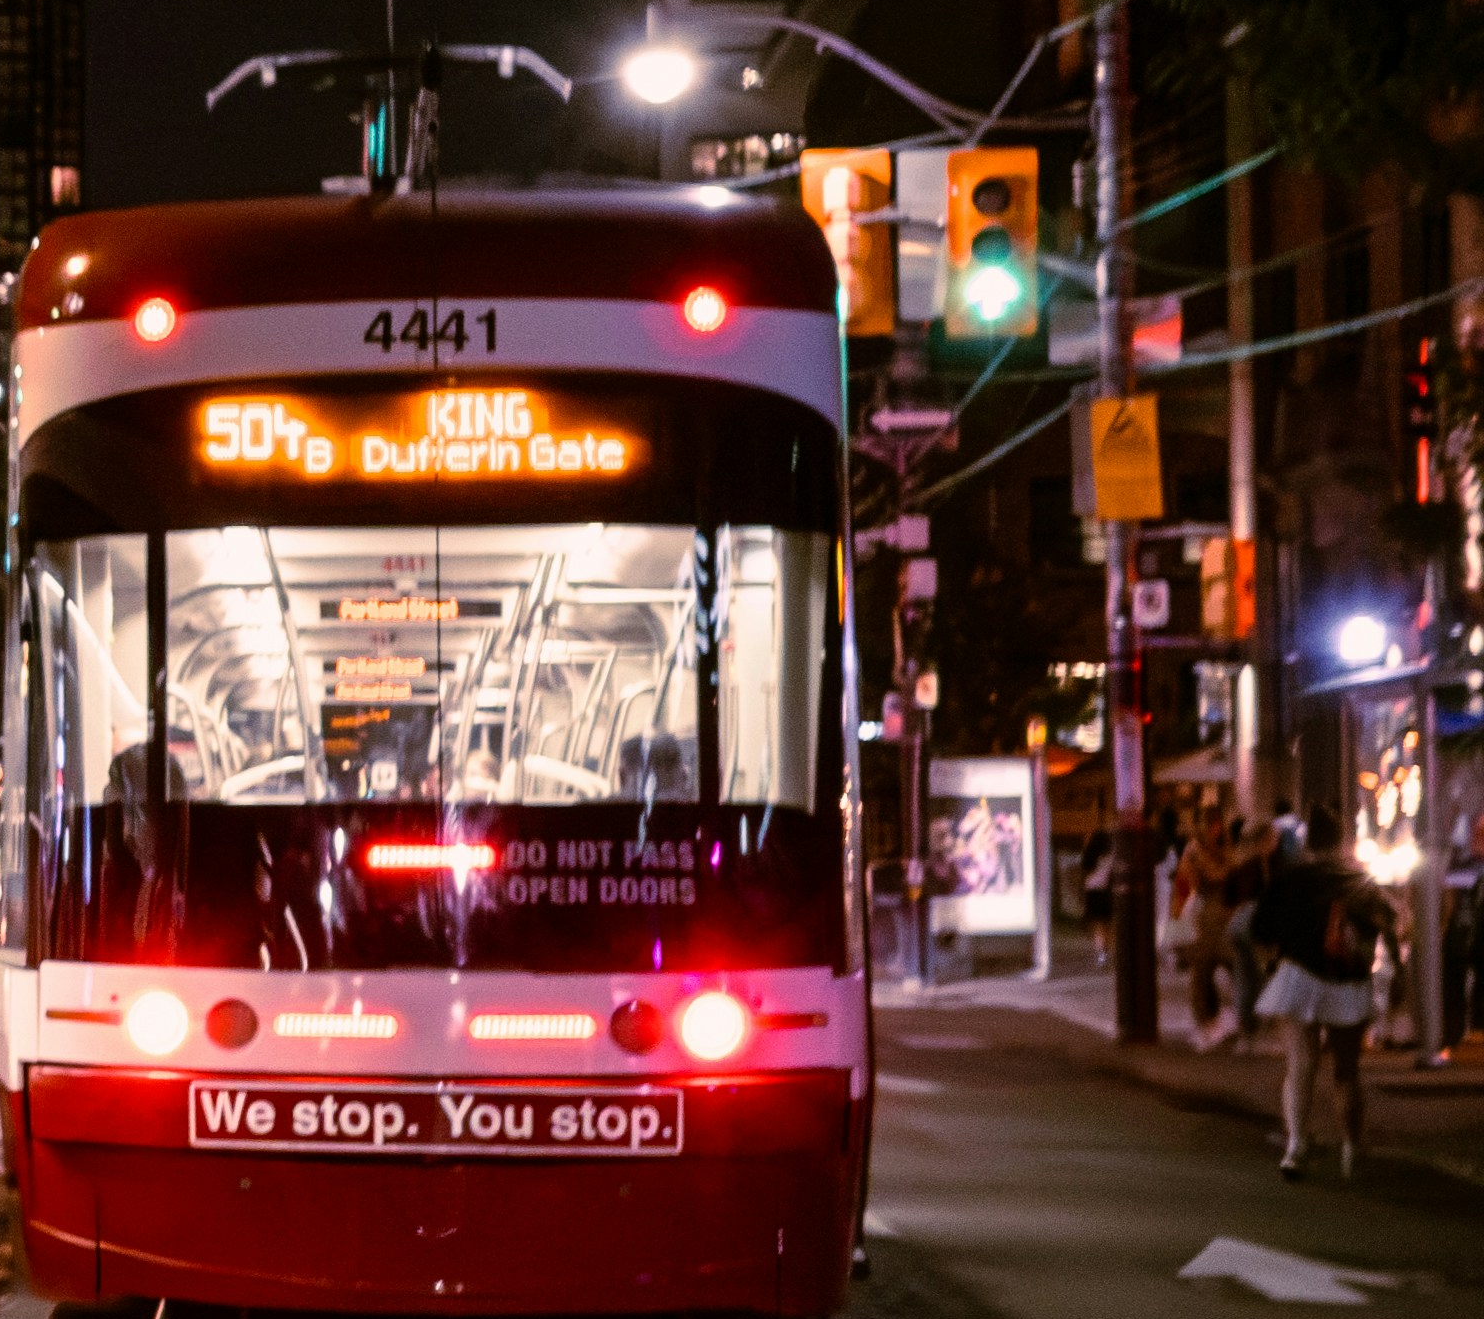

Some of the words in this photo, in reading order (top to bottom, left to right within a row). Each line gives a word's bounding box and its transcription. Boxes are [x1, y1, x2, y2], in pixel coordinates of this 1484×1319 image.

[364, 307, 496, 353] 4441
[428, 391, 532, 439] KING
[361, 435, 521, 472] Dufferin
[528, 434, 625, 471] Gate
[507, 840, 546, 868] DO
[557, 840, 613, 868] NOT
[623, 840, 695, 870] PASS
[508, 875, 588, 905] OPEN
[599, 876, 696, 906] DOORS
[200, 1090, 277, 1136] We
[292, 1094, 420, 1146] stop.
[438, 1094, 534, 1140] You
[551, 1098, 674, 1151] stop.
